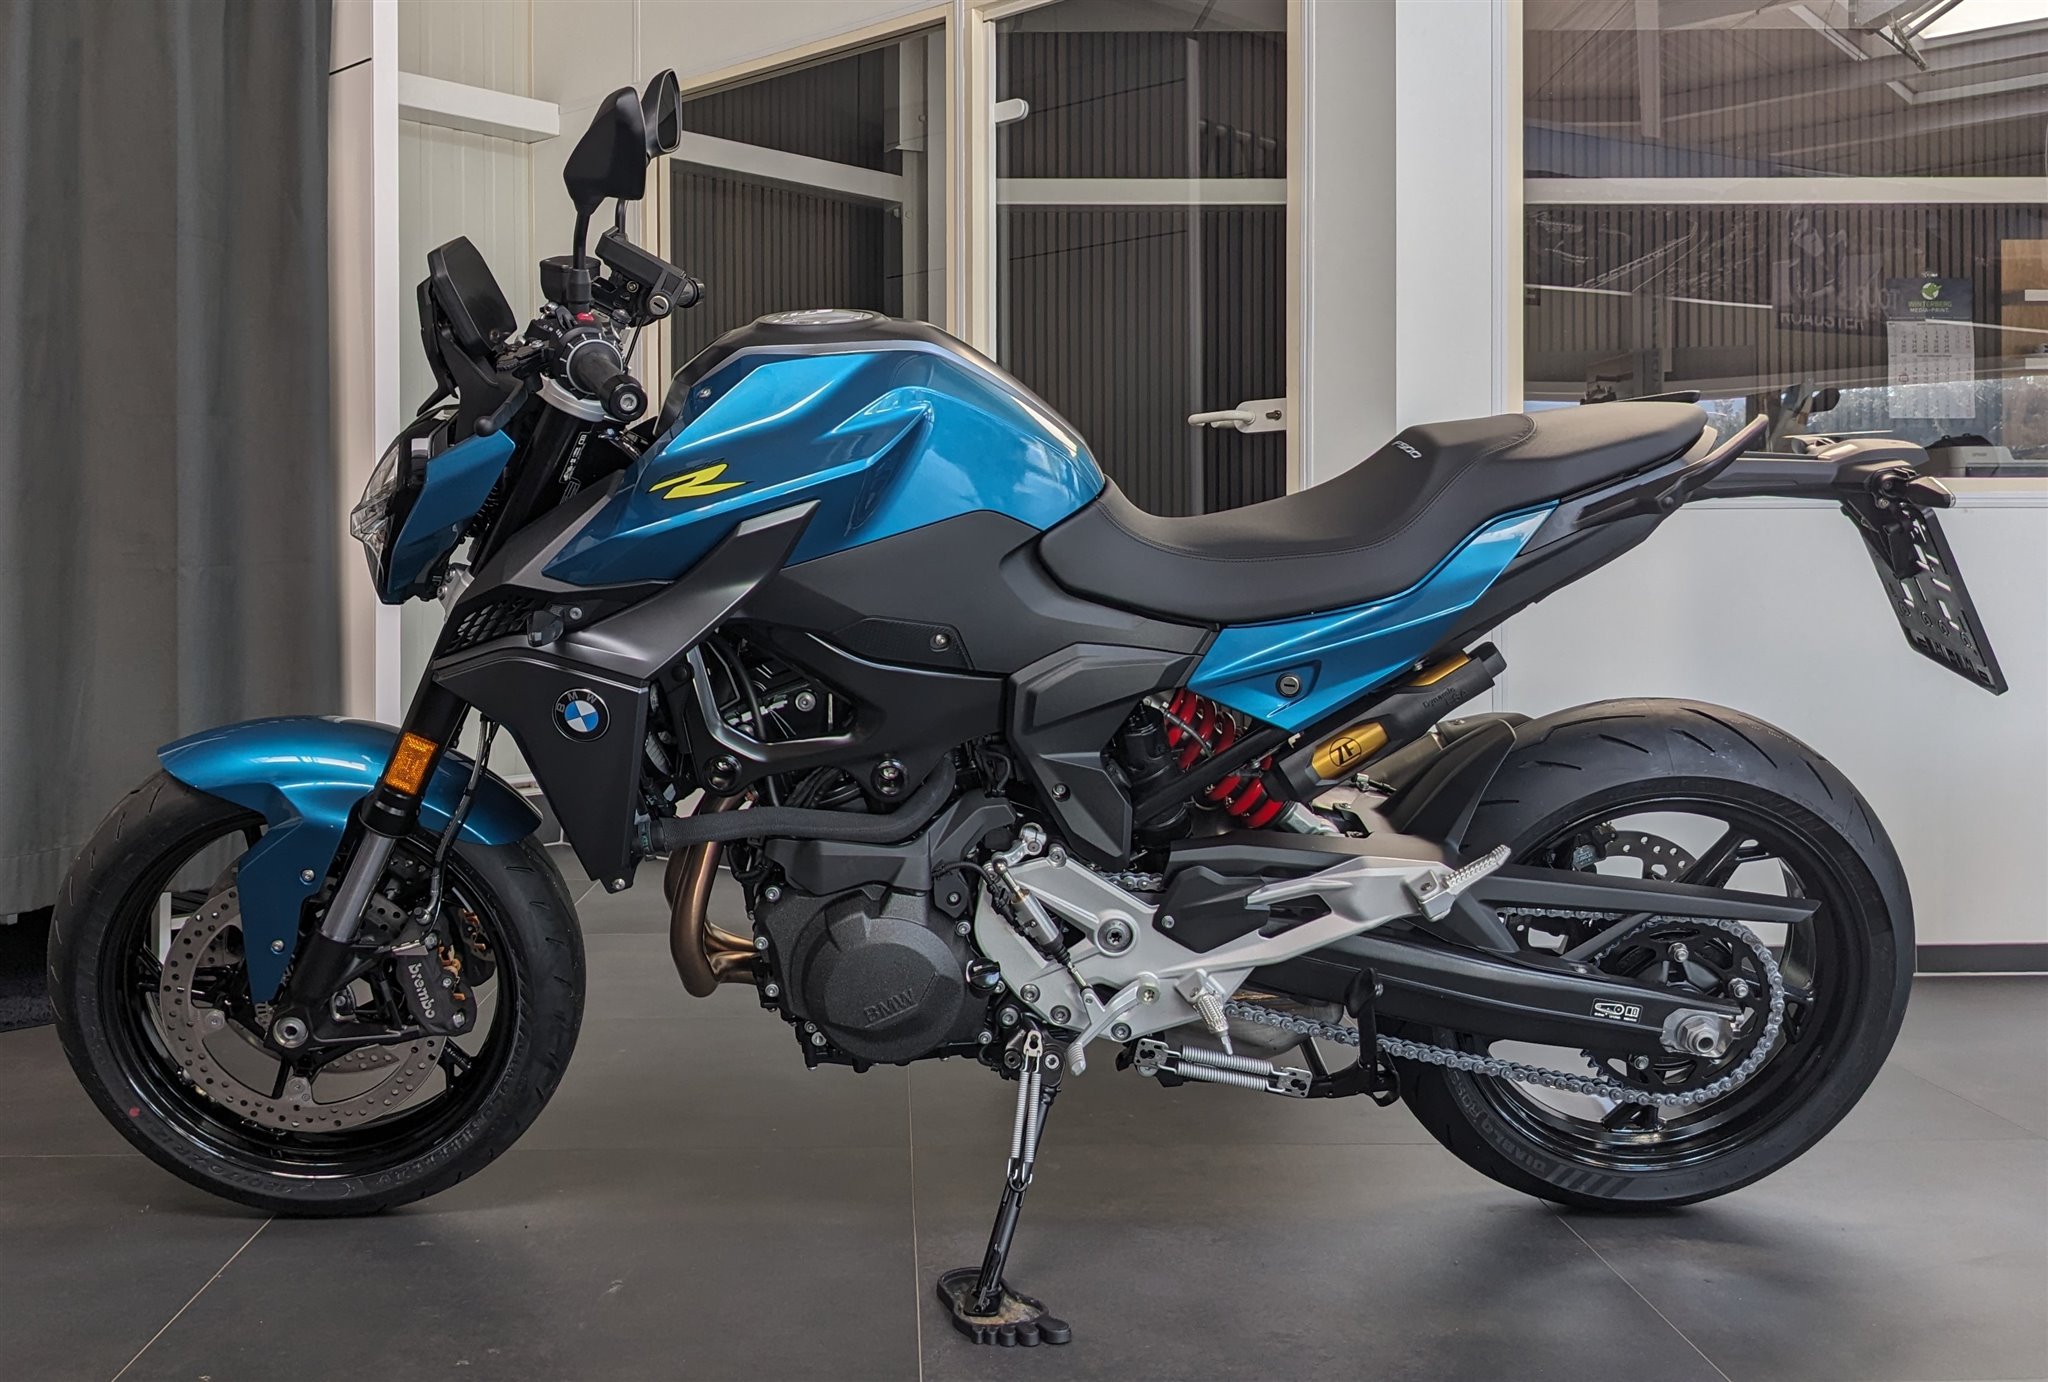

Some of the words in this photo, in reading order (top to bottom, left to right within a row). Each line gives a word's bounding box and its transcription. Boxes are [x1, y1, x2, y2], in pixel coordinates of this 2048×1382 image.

[556, 690, 598, 713] BMW
[1331, 739, 1361, 766] ZF
[408, 962, 436, 1019] brembo
[863, 988, 914, 1023] BMW
